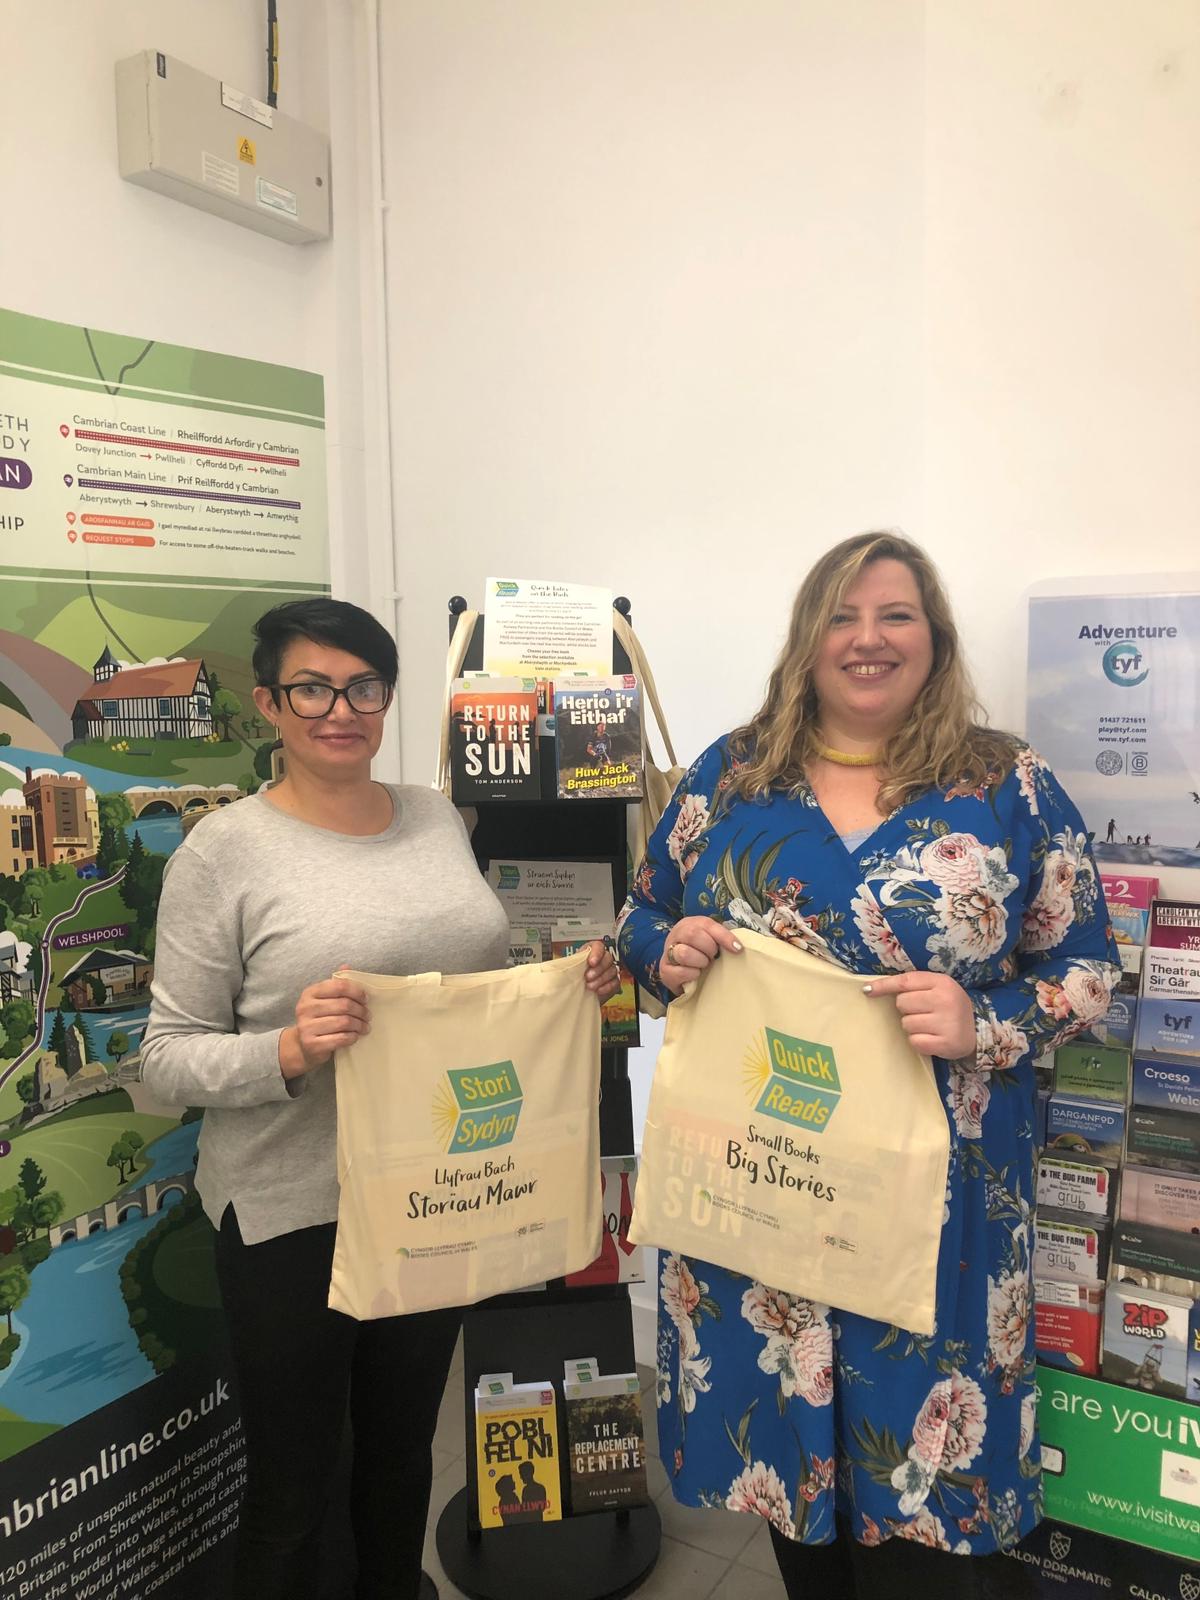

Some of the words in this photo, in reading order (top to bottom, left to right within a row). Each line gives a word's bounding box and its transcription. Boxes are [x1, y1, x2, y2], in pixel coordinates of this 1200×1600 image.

[73, 414, 118, 430] Cambrian
[120, 421, 145, 433] Coast
[148, 426, 166, 437] Line
[177, 429, 223, 444] Rheilffordd
[225, 436, 256, 448] Arfordir
[256, 443, 262, 451] y
[263, 441, 299, 454] Cambrian
[75, 443, 101, 455] Dovey
[103, 446, 137, 458] Junction
[155, 453, 185, 465] Pwllheli
[196, 458, 227, 470] Cyffordd
[229, 462, 244, 472] Dyfi
[260, 466, 287, 477] Pwllheli
[77, 463, 121, 478] Cambrian
[124, 469, 146, 480] Main
[148, 471, 167, 482] Line
[178, 475, 193, 485] Prif
[195, 477, 234, 490] Reilffordd
[235, 484, 240, 492] y
[242, 482, 279, 494] Cambrian
[79, 493, 132, 505] Aberystwyth
[150, 499, 195, 512] Shrewsbury
[206, 505, 251, 517] Aberystwyth
[266, 511, 299, 523] Amwythig
[85, 534, 113, 543] REQUEST
[115, 536, 135, 544] STOPS
[1078, 624, 1177, 640] Adventure
[1095, 639, 1111, 647] with
[1110, 654, 1143, 674] tyf
[561, 693, 610, 710] Herio
[615, 692, 633, 708] i'r
[463, 704, 530, 722] RETURN
[570, 708, 626, 725] Eithaf
[463, 725, 486, 742] TO
[495, 724, 530, 741] THE
[1098, 736, 1146, 744] www.tyf.com
[465, 742, 531, 776] SUN
[575, 767, 601, 778] Huw
[602, 763, 629, 775] Jack
[567, 773, 637, 790] Brassington
[58, 927, 125, 948] WELSHPOOL
[1150, 975, 1166, 985] Sir
[1168, 976, 1190, 987] Gâr
[1164, 1013, 1193, 1031] tyf
[609, 1034, 629, 1042] JONES
[773, 1038, 834, 1082] Quick
[460, 1070, 512, 1101] Stori
[1144, 1067, 1190, 1083] Croeso
[764, 1083, 830, 1125] Reads
[1052, 1108, 1115, 1125] DARGANFOD
[457, 1113, 517, 1147] Sydyn
[747, 1124, 783, 1152] Small
[784, 1137, 821, 1165] Books
[435, 1168, 482, 1187] Llyfrau
[484, 1155, 515, 1178] Bach
[726, 1139, 758, 1185] Big
[764, 1155, 837, 1202] Stories
[1049, 1170, 1061, 1180] THE
[1062, 1172, 1076, 1182] BUG
[1077, 1174, 1096, 1186] FARM
[486, 1179, 538, 1206] Mawr
[1057, 1191, 1086, 1210] grub
[1037, 1231, 1050, 1241] THE
[1051, 1233, 1065, 1243] BUG
[1066, 1235, 1086, 1247] FARM
[1047, 1252, 1076, 1271] grub
[1123, 1323, 1166, 1339] WORLD
[1051, 1390, 1103, 1420] are
[1112, 1404, 1173, 1440] you
[485, 1417, 551, 1444] POBL
[593, 1422, 619, 1437] THE
[484, 1438, 522, 1464] FEL
[527, 1434, 554, 1460] NI
[574, 1436, 640, 1456] REPLACEMENT
[576, 1451, 641, 1474] CENTRE
[0, 1559, 27, 1585] 120
[30, 1537, 67, 1568] miles
[69, 1521, 84, 1543] of
[86, 1490, 138, 1532] unspoilt
[140, 1458, 182, 1497] natural
[184, 1435, 220, 1466] beauty
[222, 1417, 241, 1440] and
[19, 1561, 70, 1598] Britain.
[73, 1535, 106, 1563] From
[109, 1485, 178, 1540] Shrewsbury
[180, 1475, 191, 1490] in
[45, 1582, 68, 1600] the
[71, 1550, 113, 1587] border
[115, 1533, 140, 1557] into
[142, 1506, 179, 1536] Wales,
[181, 1470, 224, 1508] through
[75, 1566, 113, 1600] World
[116, 1533, 166, 1577] Heritage
[168, 1512, 194, 1539] sites
[195, 1493, 216, 1518] and
[105, 1584, 119, 1600] of
[121, 1561, 159, 1591] Wales.
[162, 1536, 188, 1563] Here
[190, 1528, 200, 1540] it
[201, 1499, 239, 1534] merges
[144, 1556, 185, 1596] coastal
[187, 1534, 218, 1563] walks
[220, 1515, 240, 1539] and
[1001, 1547, 1041, 1566] CALON
[1043, 1558, 1112, 1588] DDRAMATIG
[1041, 1570, 1068, 1584] CYMRU
